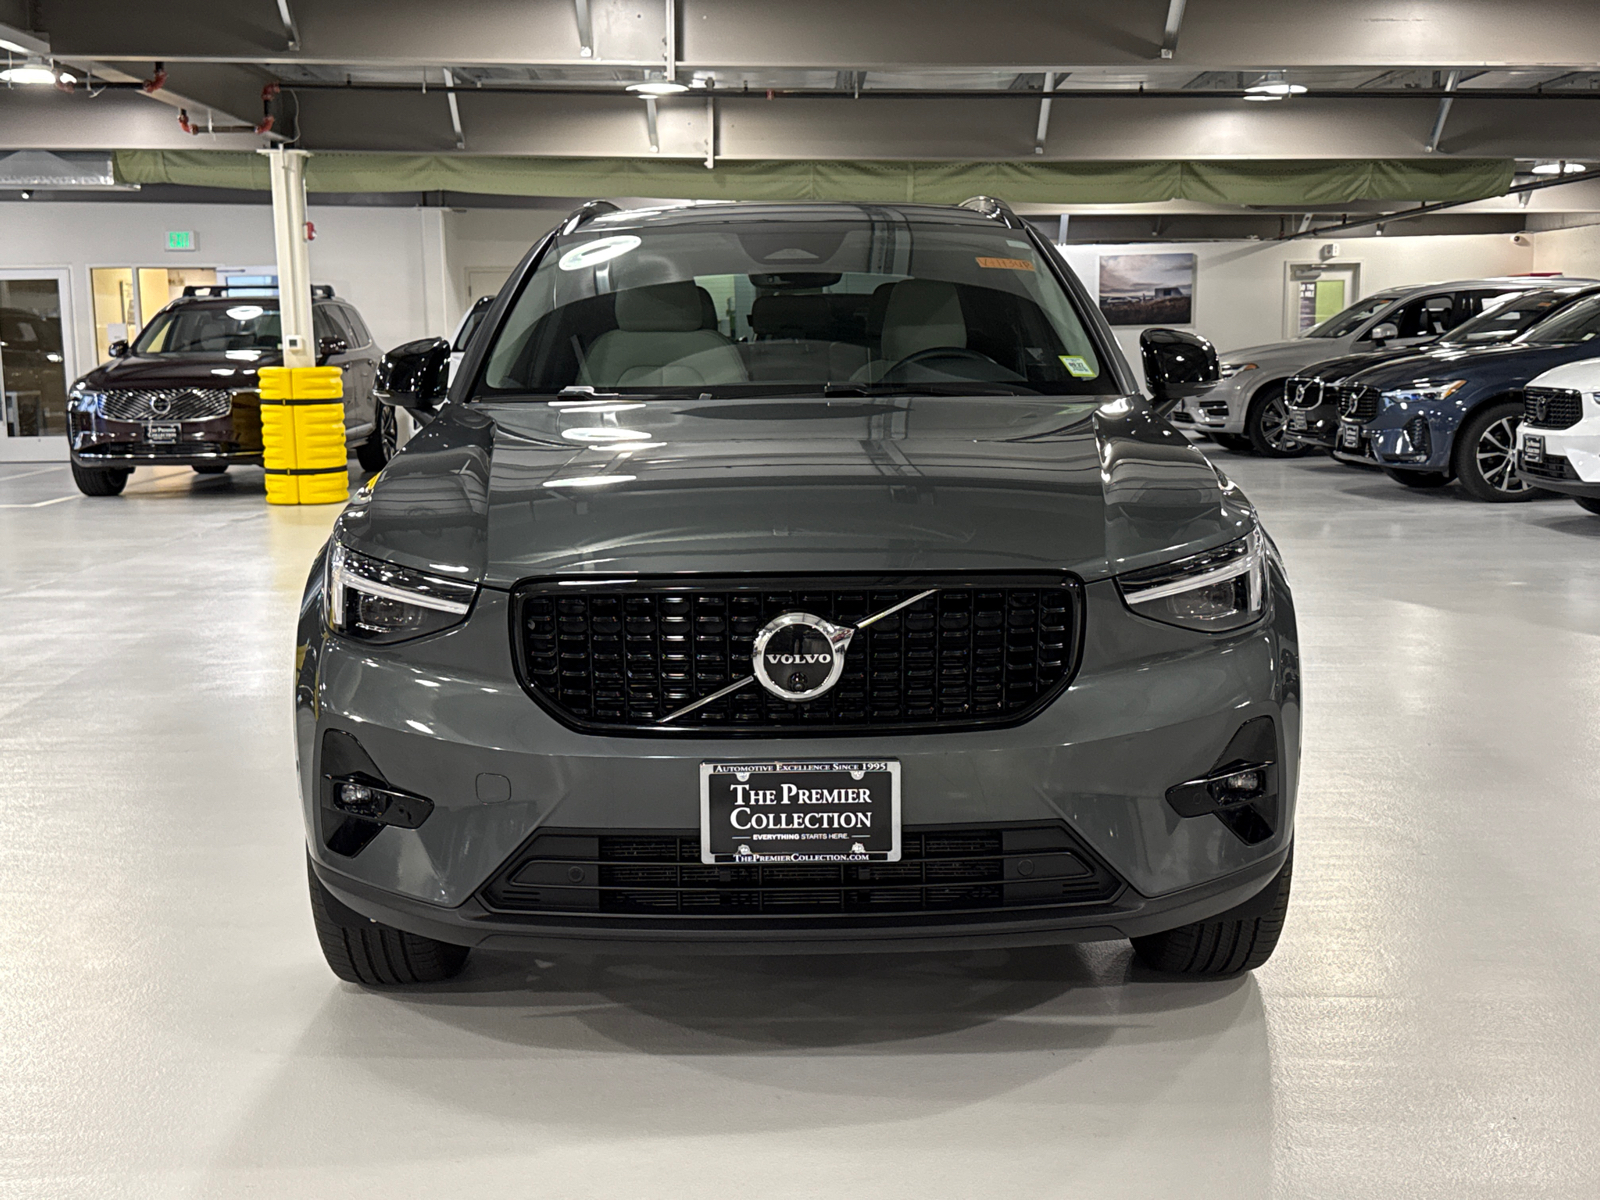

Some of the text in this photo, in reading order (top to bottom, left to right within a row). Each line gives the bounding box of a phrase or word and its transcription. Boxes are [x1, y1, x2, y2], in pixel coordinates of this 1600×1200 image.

[169, 231, 190, 248] EXIT
[766, 654, 831, 664] VOLVO
[715, 762, 886, 773] AUTOMOTIVE EXCELLENCE SINCE 1995
[730, 783, 872, 805] THE PREMIER
[730, 806, 873, 830] COLLECTION
[752, 832, 850, 841] EVERYTHING STARTS HERE.
